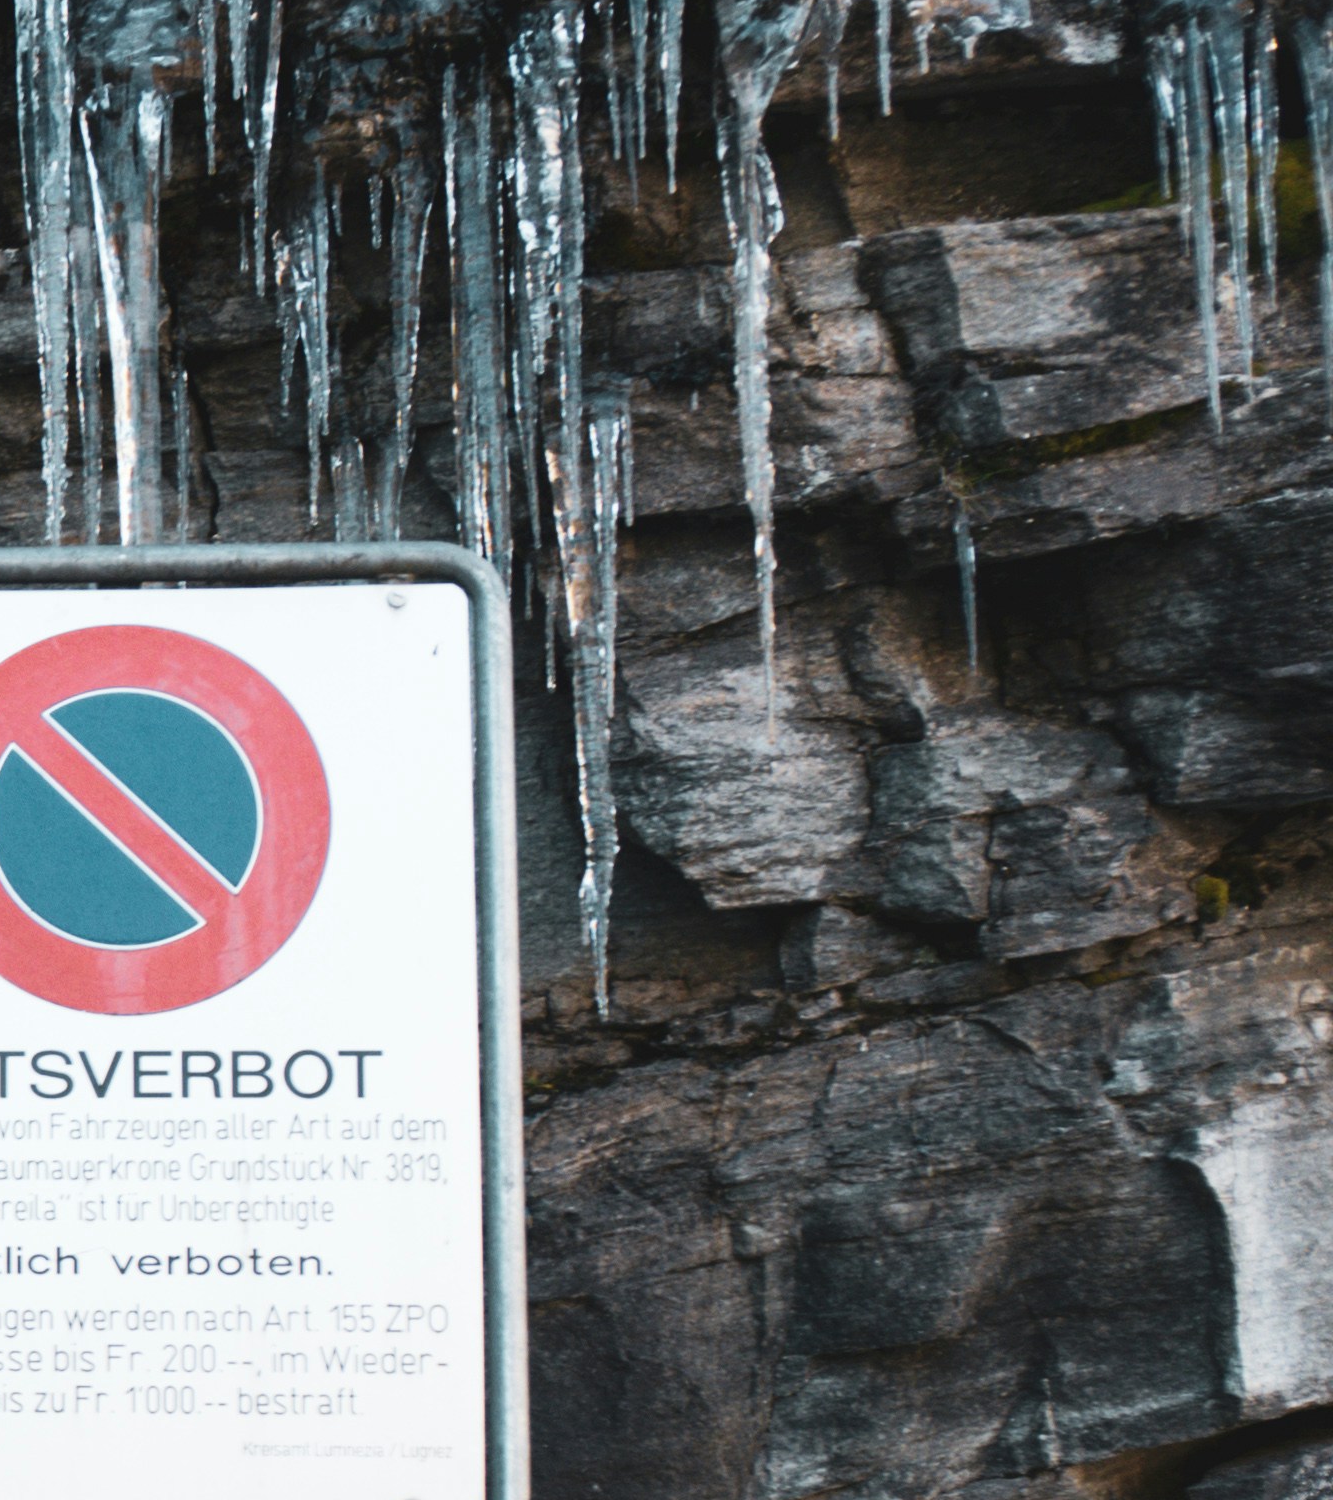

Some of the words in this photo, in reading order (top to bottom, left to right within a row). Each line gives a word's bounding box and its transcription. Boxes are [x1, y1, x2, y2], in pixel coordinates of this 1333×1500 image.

[49, 1112, 207, 1148] Fahrzeugen
[215, 1112, 278, 1141] aller
[287, 1113, 332, 1141] Art
[340, 1112, 381, 1141] auf
[390, 1112, 447, 1141] dem
[188, 1151, 334, 1182] Grundstück
[385, 1152, 448, 1185] 3819,
[78, 1192, 107, 1222] ist
[115, 1192, 152, 1222] für
[159, 1192, 335, 1230] Unberechtigte
[113, 1246, 335, 1276] verboten.
[64, 1303, 175, 1332] werden
[184, 1304, 253, 1332] nach
[329, 1304, 375, 1333] 155
[385, 1304, 449, 1334] ZPO
[54, 1342, 95, 1372] bis
[271, 1343, 309, 1374] im
[319, 1344, 448, 1375] Wieder-
[34, 1392, 66, 1413] zu
